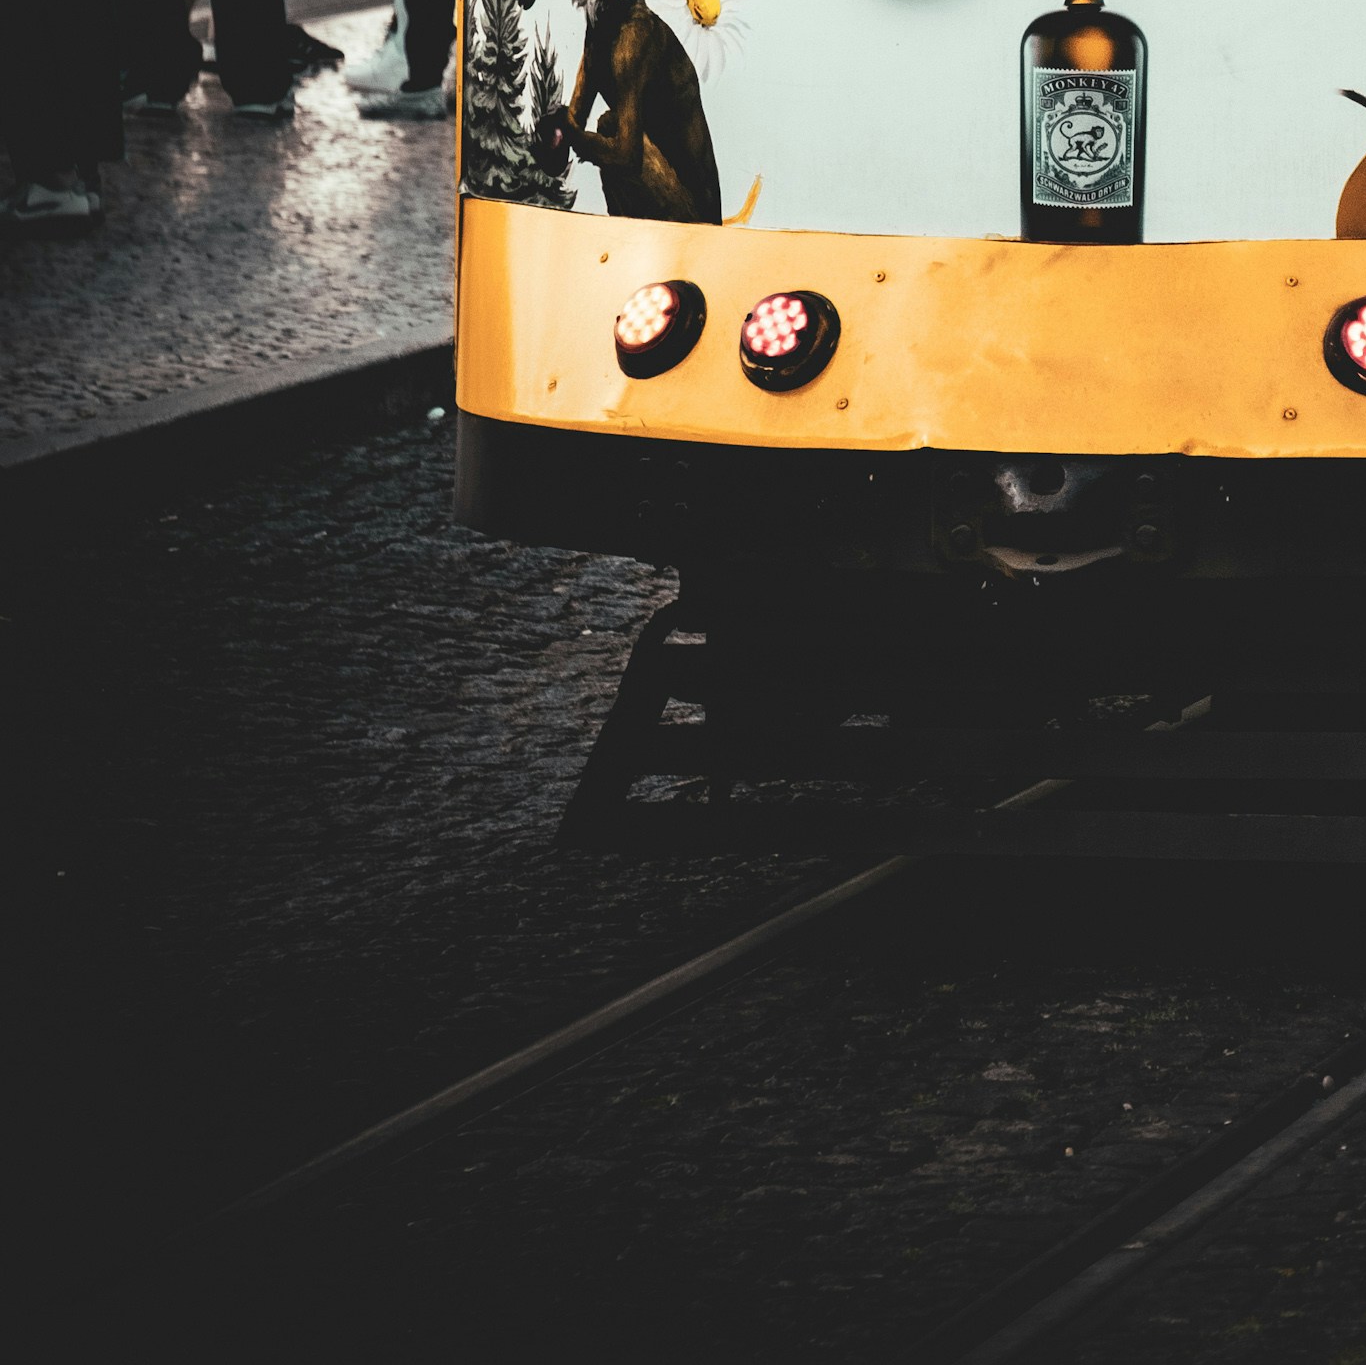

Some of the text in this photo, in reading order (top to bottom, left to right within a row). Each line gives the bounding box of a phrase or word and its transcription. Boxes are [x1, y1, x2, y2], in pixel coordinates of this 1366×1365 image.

[1043, 77, 1126, 96] MONKEY 47
[1039, 176, 1126, 202] SCHWARZWALD DRY GIN
